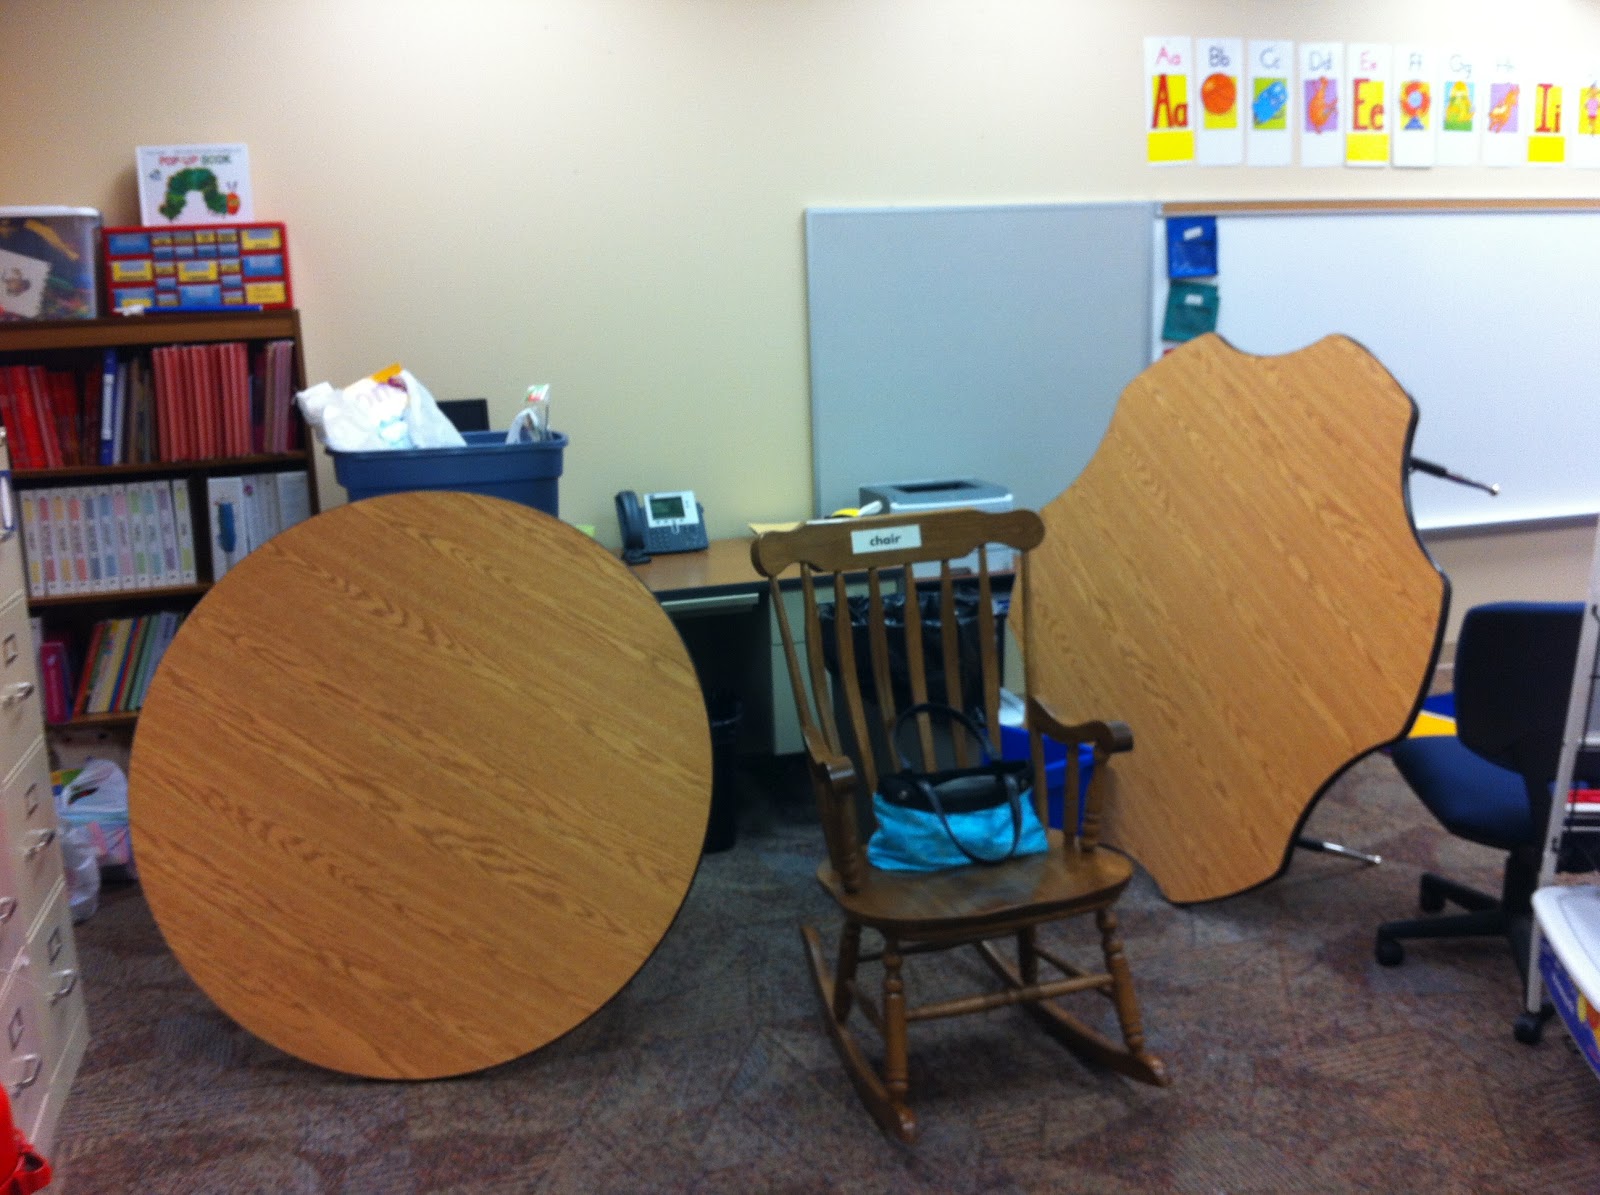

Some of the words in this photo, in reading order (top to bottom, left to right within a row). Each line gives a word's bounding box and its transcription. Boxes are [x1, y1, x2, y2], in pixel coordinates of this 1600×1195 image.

[1156, 46, 1182, 65] Aa
[1209, 45, 1231, 67] Bb
[1310, 51, 1333, 71] Dd
[1152, 74, 1188, 128] Aa
[1353, 78, 1385, 130] Ee
[1535, 83, 1560, 133] Ii
[869, 533, 902, 547] chair
